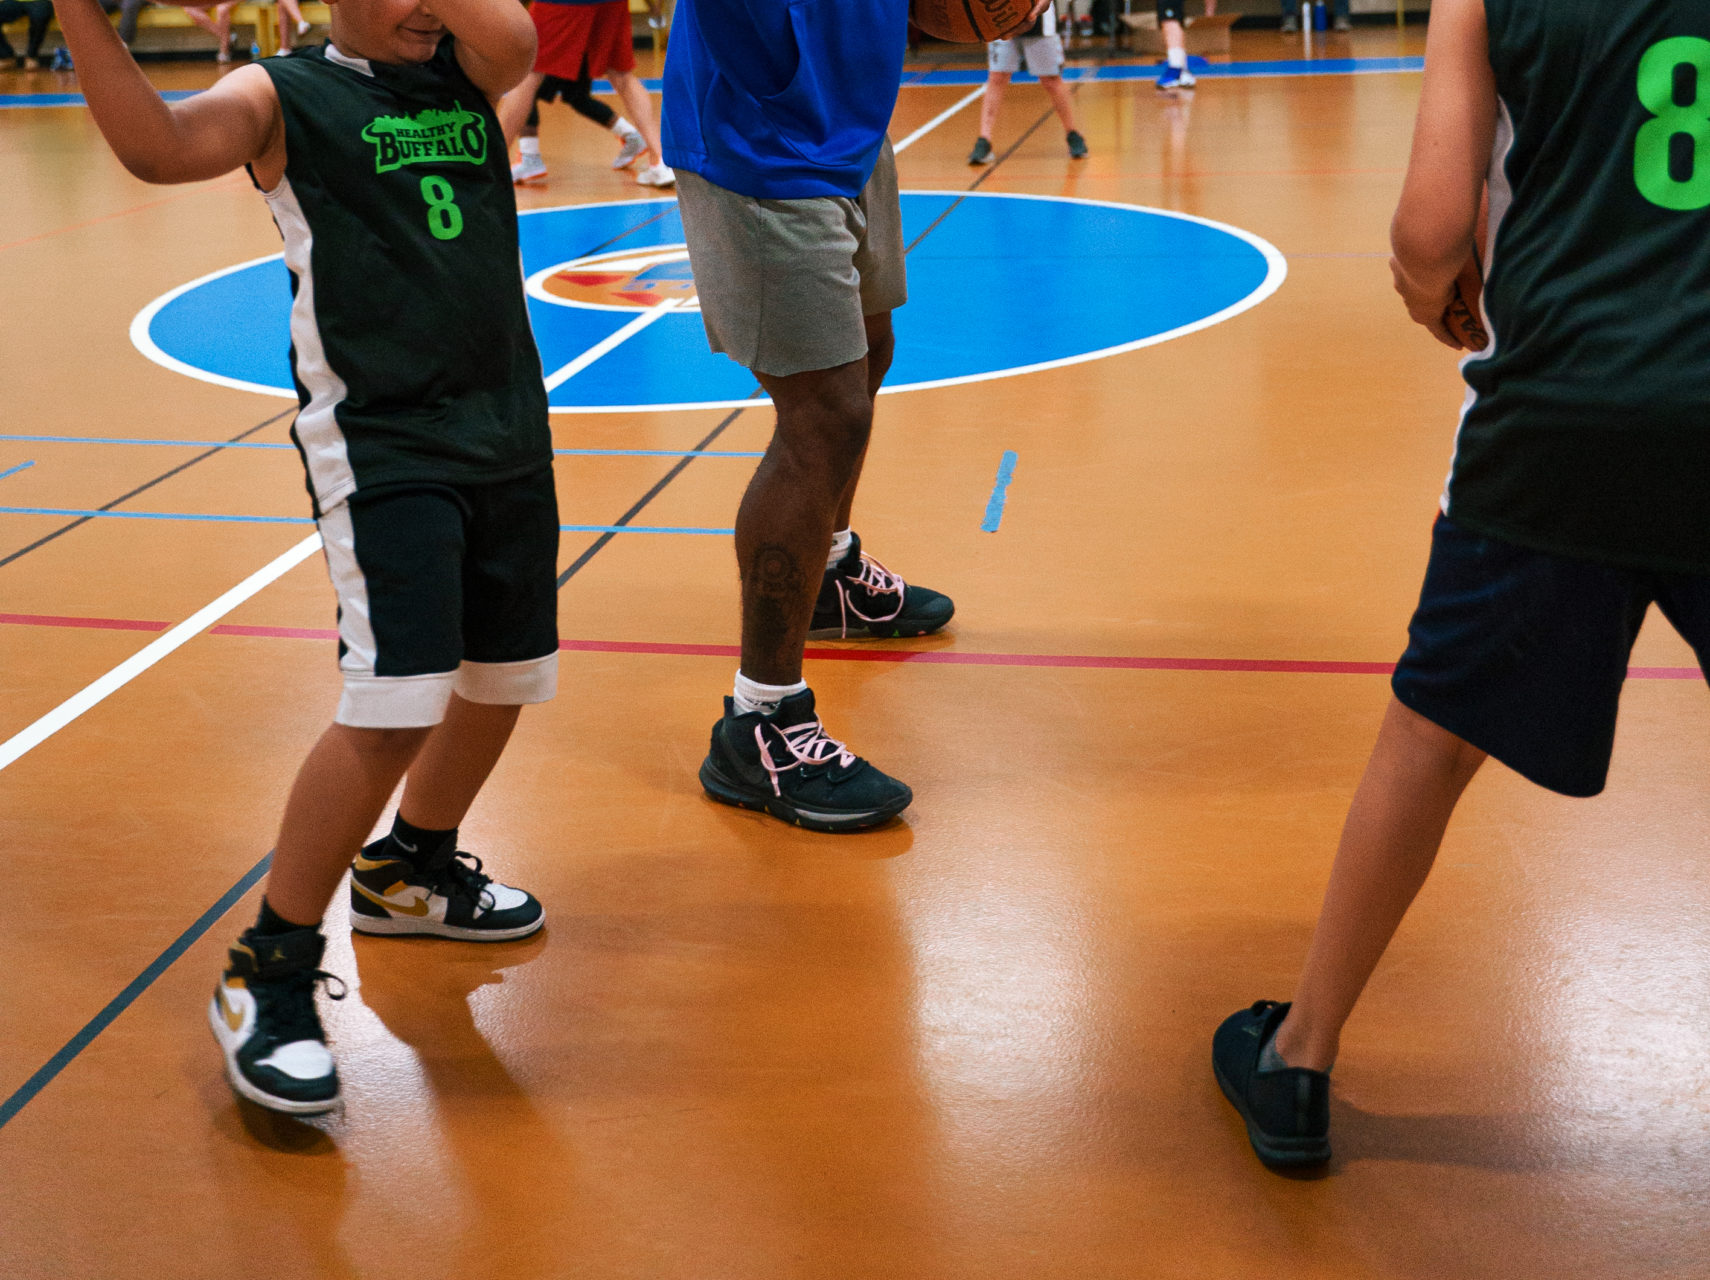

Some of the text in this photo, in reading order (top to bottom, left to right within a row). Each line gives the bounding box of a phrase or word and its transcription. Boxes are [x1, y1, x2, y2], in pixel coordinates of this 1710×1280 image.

[371, 121, 485, 166] BUFFALO
[396, 122, 456, 139] HEALTHY
[1633, 35, 1710, 211] 8
[420, 175, 464, 241] 8
